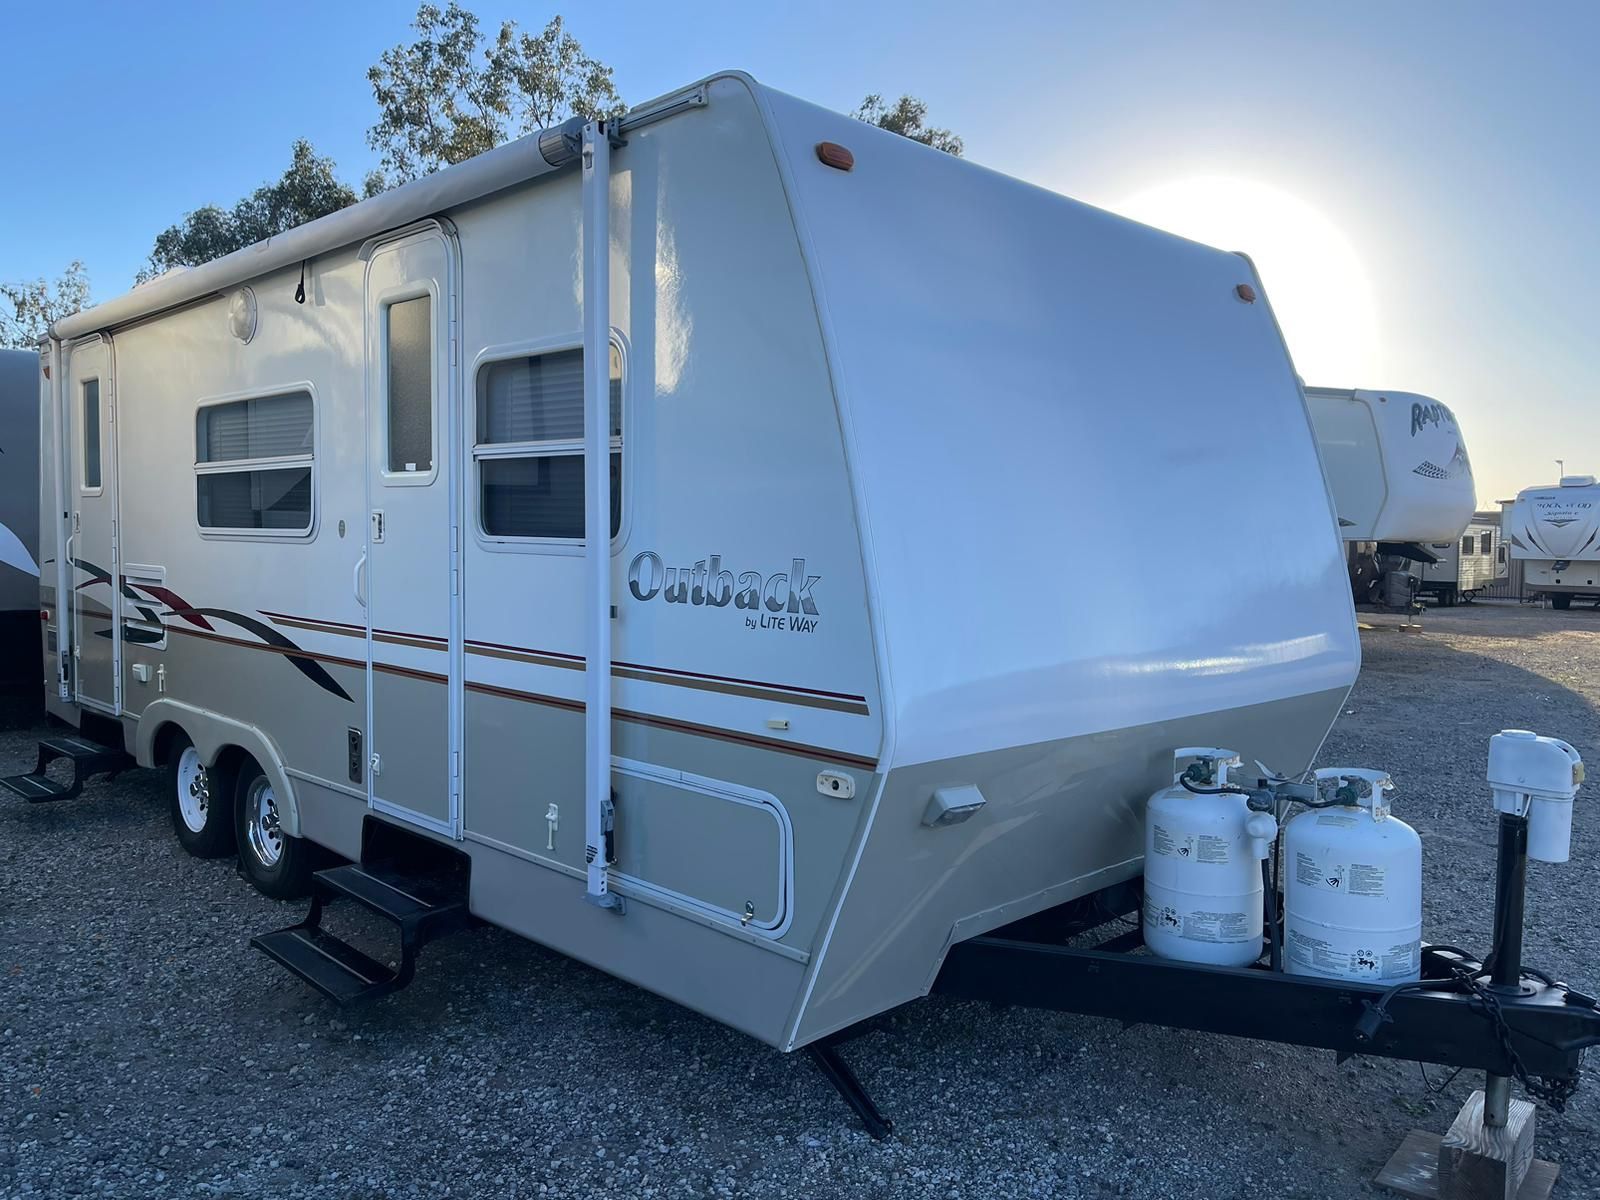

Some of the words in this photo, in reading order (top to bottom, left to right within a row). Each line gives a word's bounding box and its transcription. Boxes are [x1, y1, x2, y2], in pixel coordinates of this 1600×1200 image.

[628, 550, 821, 616] Outback
[745, 616, 757, 630] by
[760, 613, 785, 630] LITE
[789, 616, 818, 633] WAY
